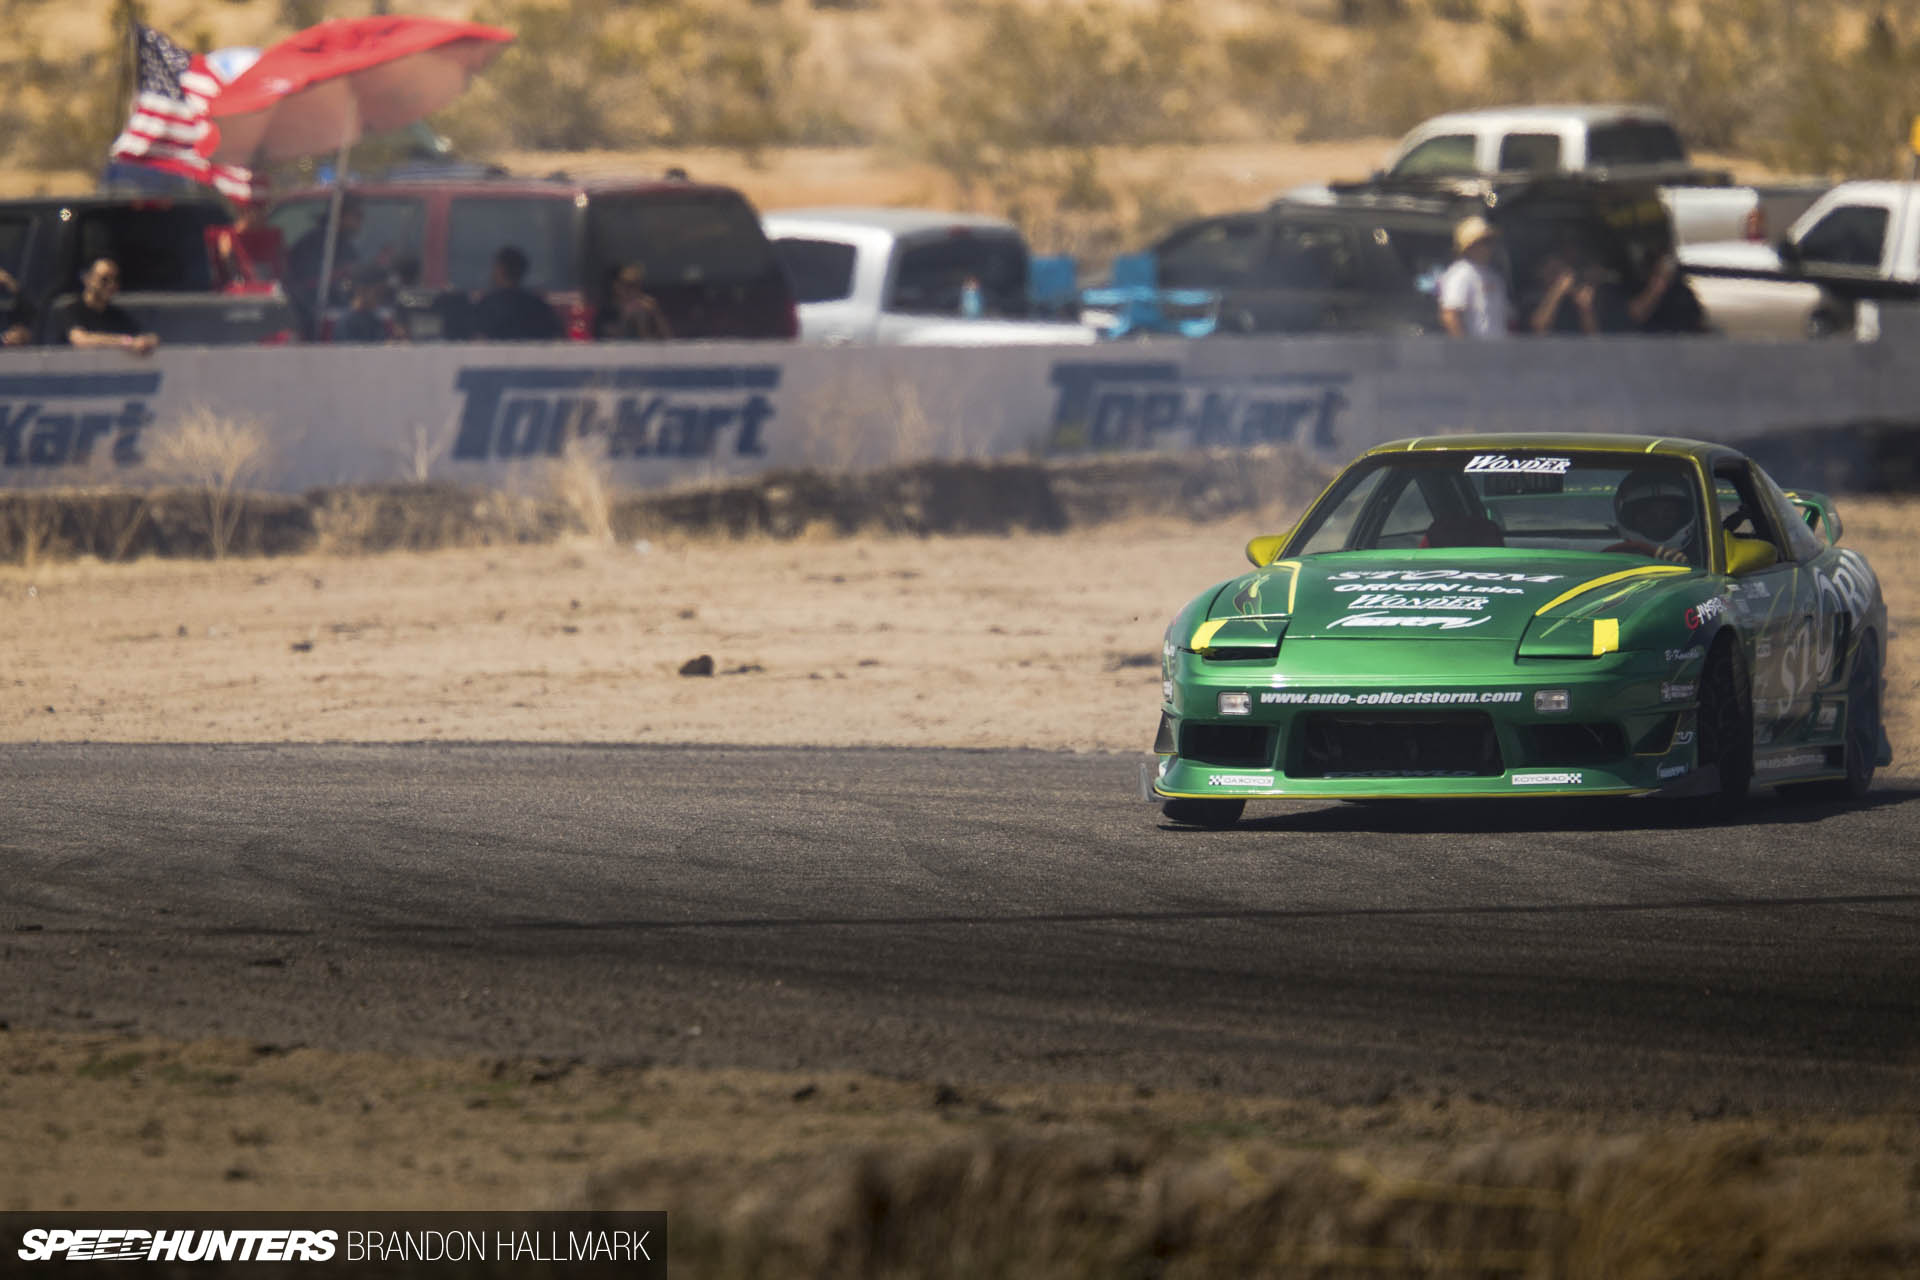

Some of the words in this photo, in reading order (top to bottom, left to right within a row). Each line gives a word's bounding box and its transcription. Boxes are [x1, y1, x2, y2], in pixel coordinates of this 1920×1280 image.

[1334, 583, 1460, 593] ORIGIN
[1348, 594, 1490, 609] WONDER
[1260, 692, 1523, 705] www.auto-collectstorm.com
